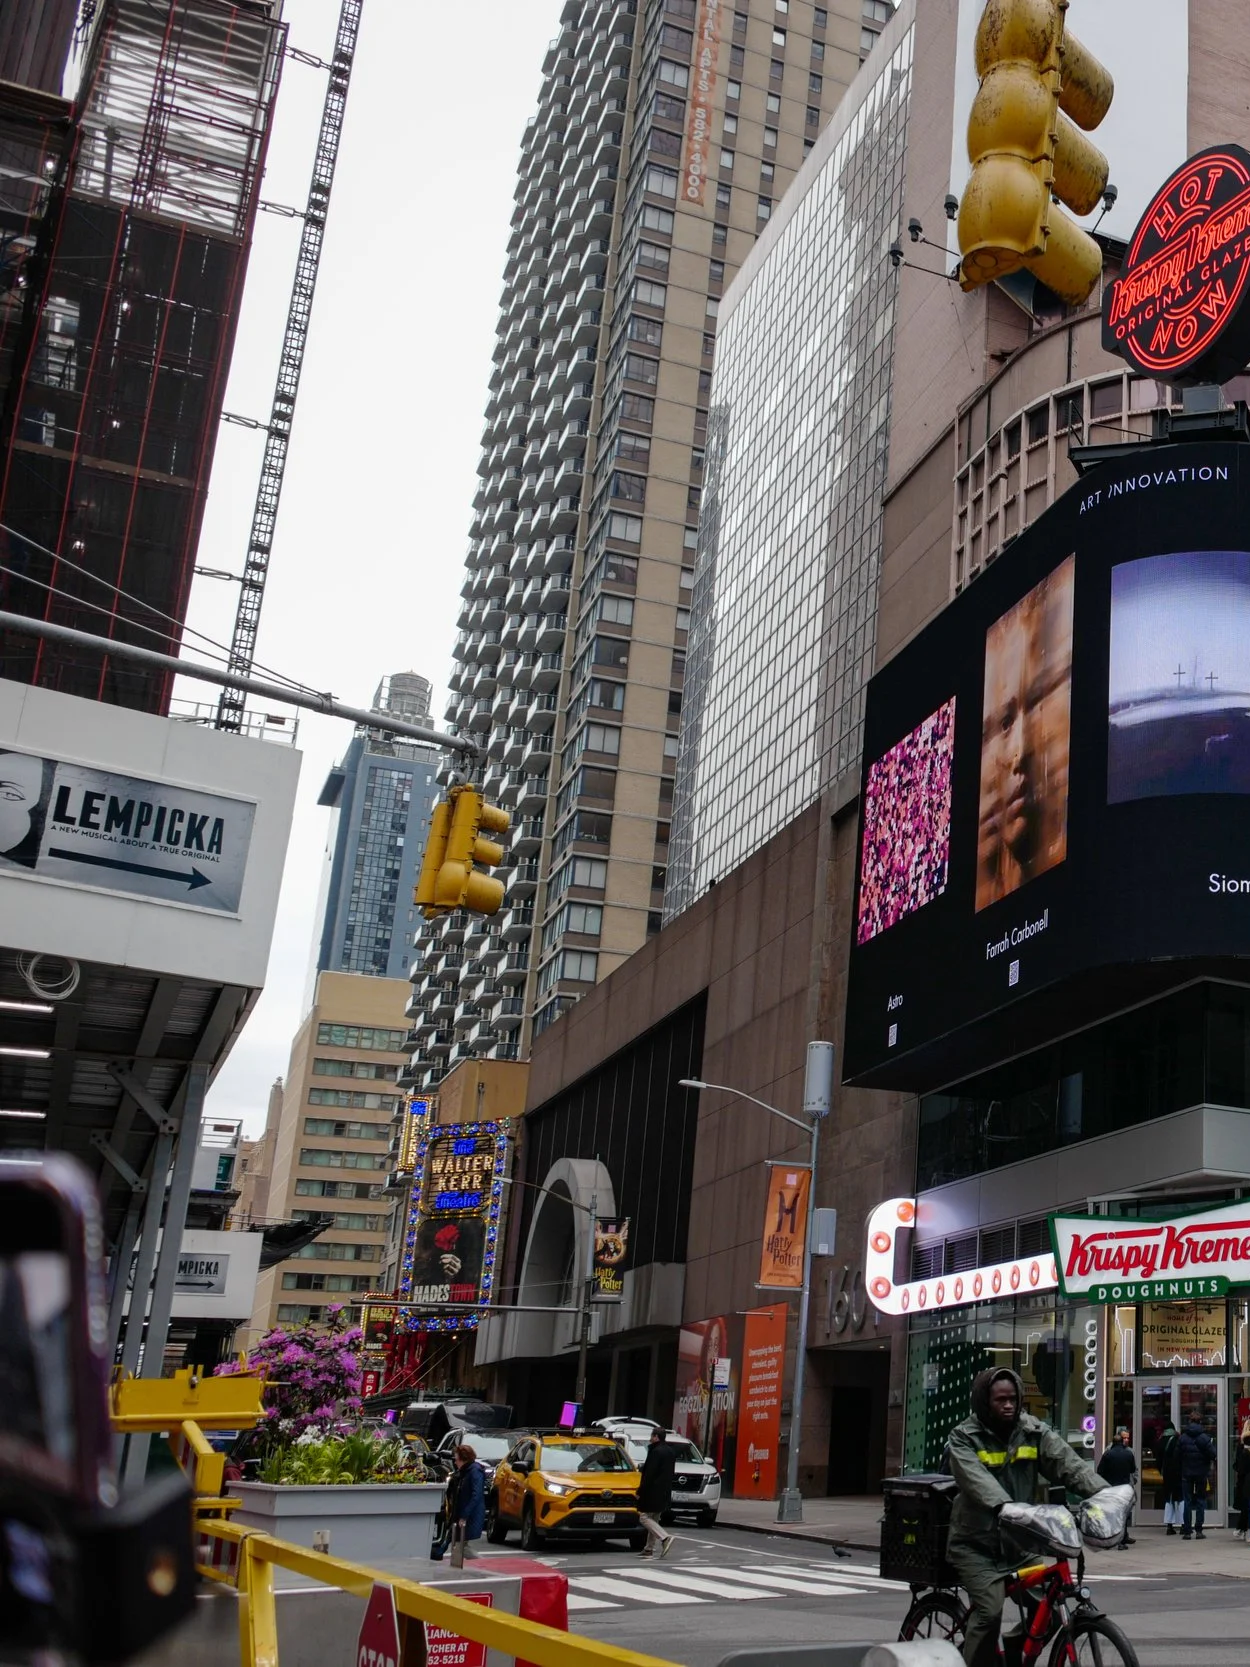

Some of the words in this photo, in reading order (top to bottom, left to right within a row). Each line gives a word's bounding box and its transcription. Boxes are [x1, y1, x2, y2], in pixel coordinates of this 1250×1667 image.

[1152, 168, 1223, 238] HOT
[1109, 231, 1191, 327] Krispy
[1115, 279, 1193, 339] ORIGINAL
[1150, 279, 1227, 354] NOW
[1079, 490, 1102, 514] ART
[53, 785, 224, 855] LEMPICKA
[81, 831, 118, 843] MUSICAL
[120, 838, 149, 848] ABOUT
[159, 845, 179, 855] TRUE
[181, 849, 221, 863] ORIGINAL
[986, 932, 1009, 960] Farrah
[1011, 908, 1049, 946] Carbonell
[431, 1155, 494, 1174] WALTER
[438, 1174, 482, 1191] KERR
[767, 1234, 792, 1253] Harry
[1065, 1227, 1164, 1278] Krispy
[178, 1260, 219, 1275] MPICKA
[773, 1249, 801, 1266] Potter
[413, 1283, 476, 1302] HADESTOWN
[599, 1279, 622, 1290] Potter
[1098, 1280, 1218, 1301] DOUGHNUTS
[1142, 1325, 1190, 1335] ORIGINAL
[1192, 1327, 1227, 1336] GLAZED
[679, 1392, 735, 1413] EGGZILAATION
[428, 1644, 456, 1653] TCHER
[457, 1643, 469, 1652] AT
[428, 1654, 465, 1665] 52-5218
